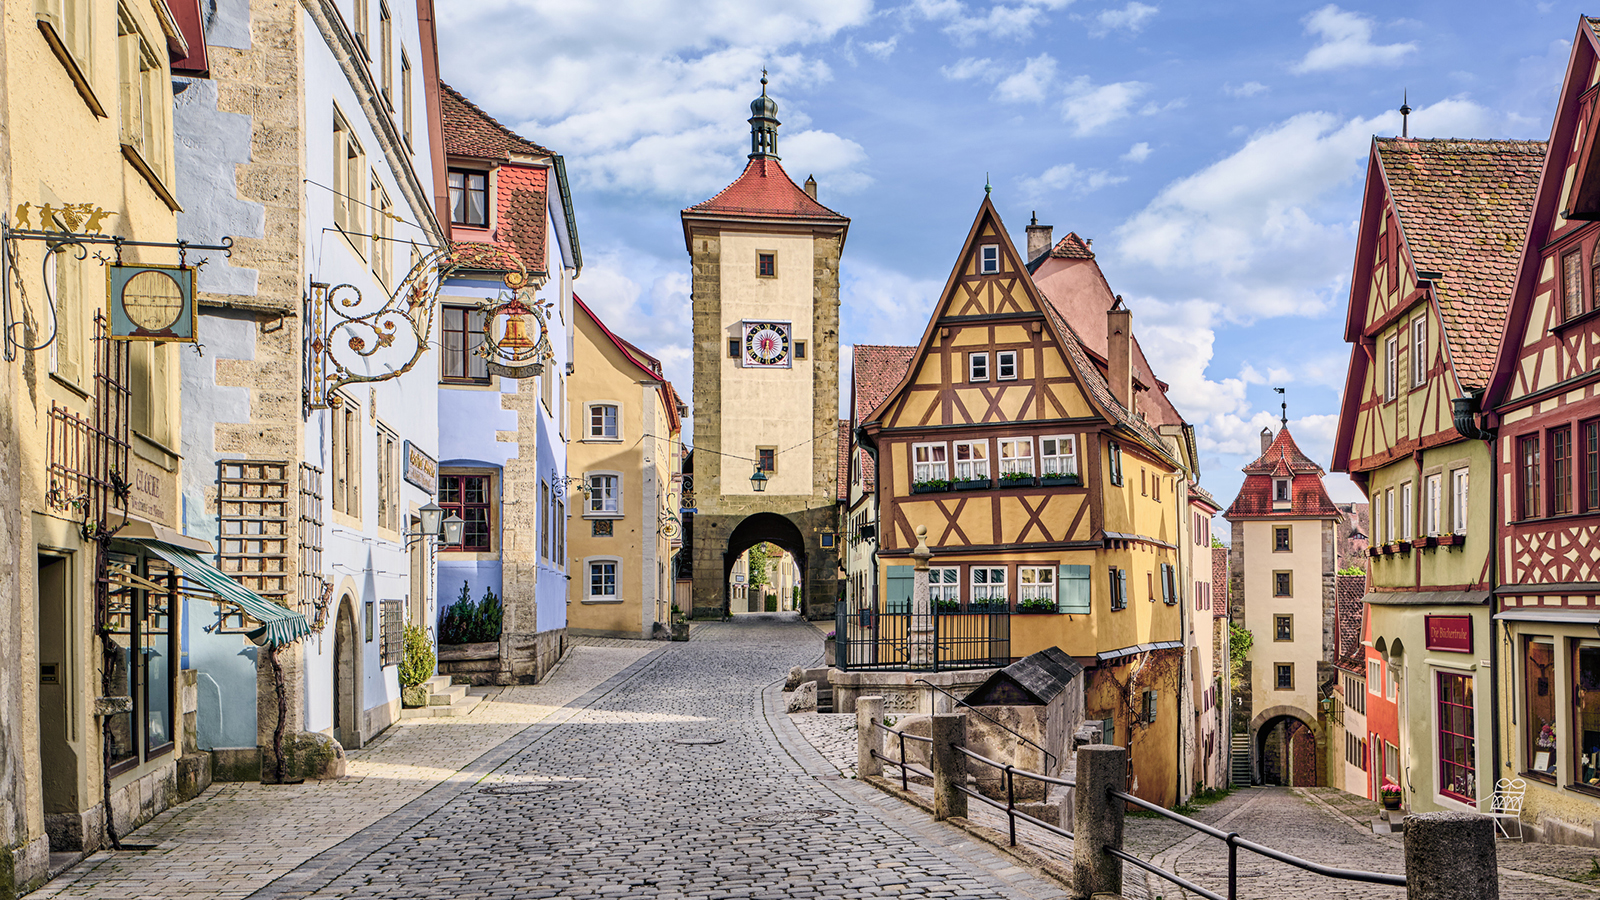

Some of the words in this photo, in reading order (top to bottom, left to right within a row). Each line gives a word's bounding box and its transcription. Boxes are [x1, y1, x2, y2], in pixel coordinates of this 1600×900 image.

[492, 365, 539, 376] GASTHOF
[1431, 626, 1439, 638] Die
[1440, 627, 1467, 640] Büchertruhe
